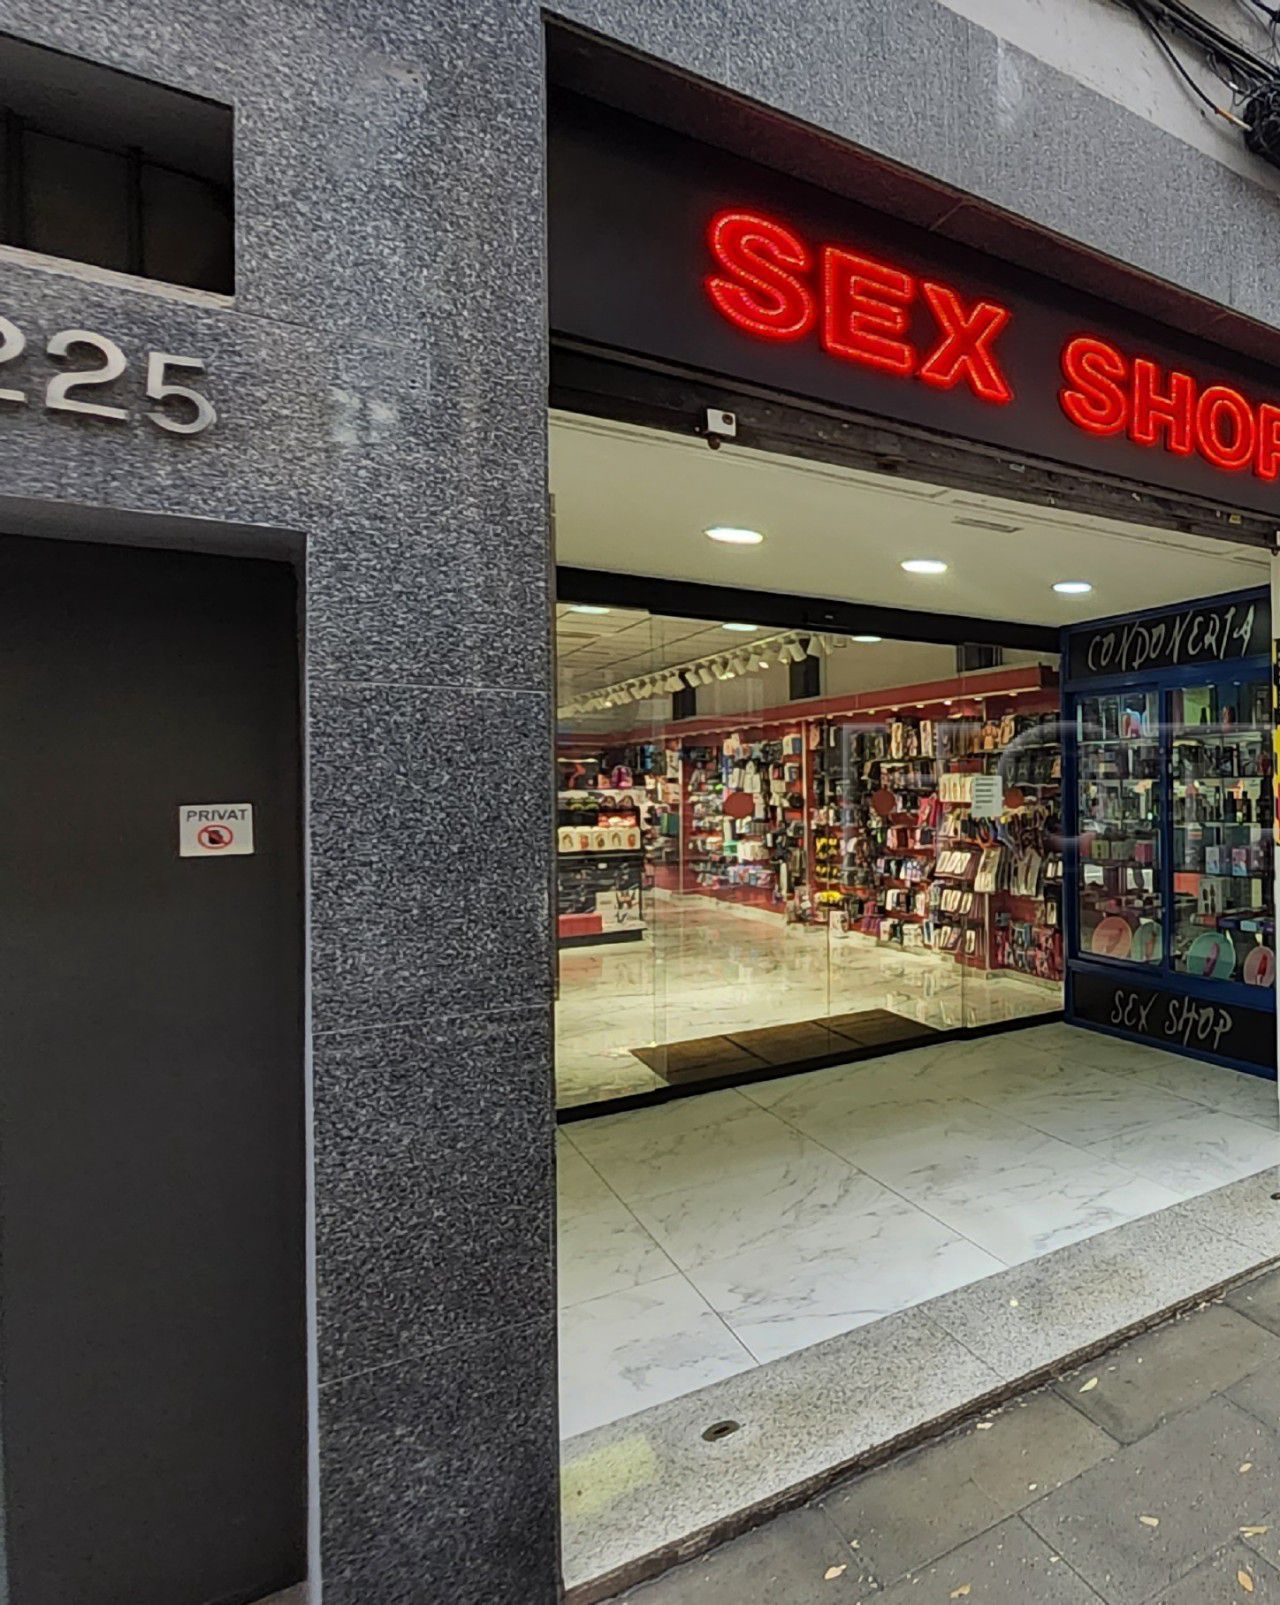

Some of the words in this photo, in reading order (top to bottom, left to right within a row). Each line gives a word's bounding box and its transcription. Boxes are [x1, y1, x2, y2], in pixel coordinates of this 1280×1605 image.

[704, 206, 1013, 402] SEX
[185, 808, 249, 824] PRIVAT
[1110, 990, 1160, 1032] SEX
[1164, 995, 1233, 1051] SHOP
